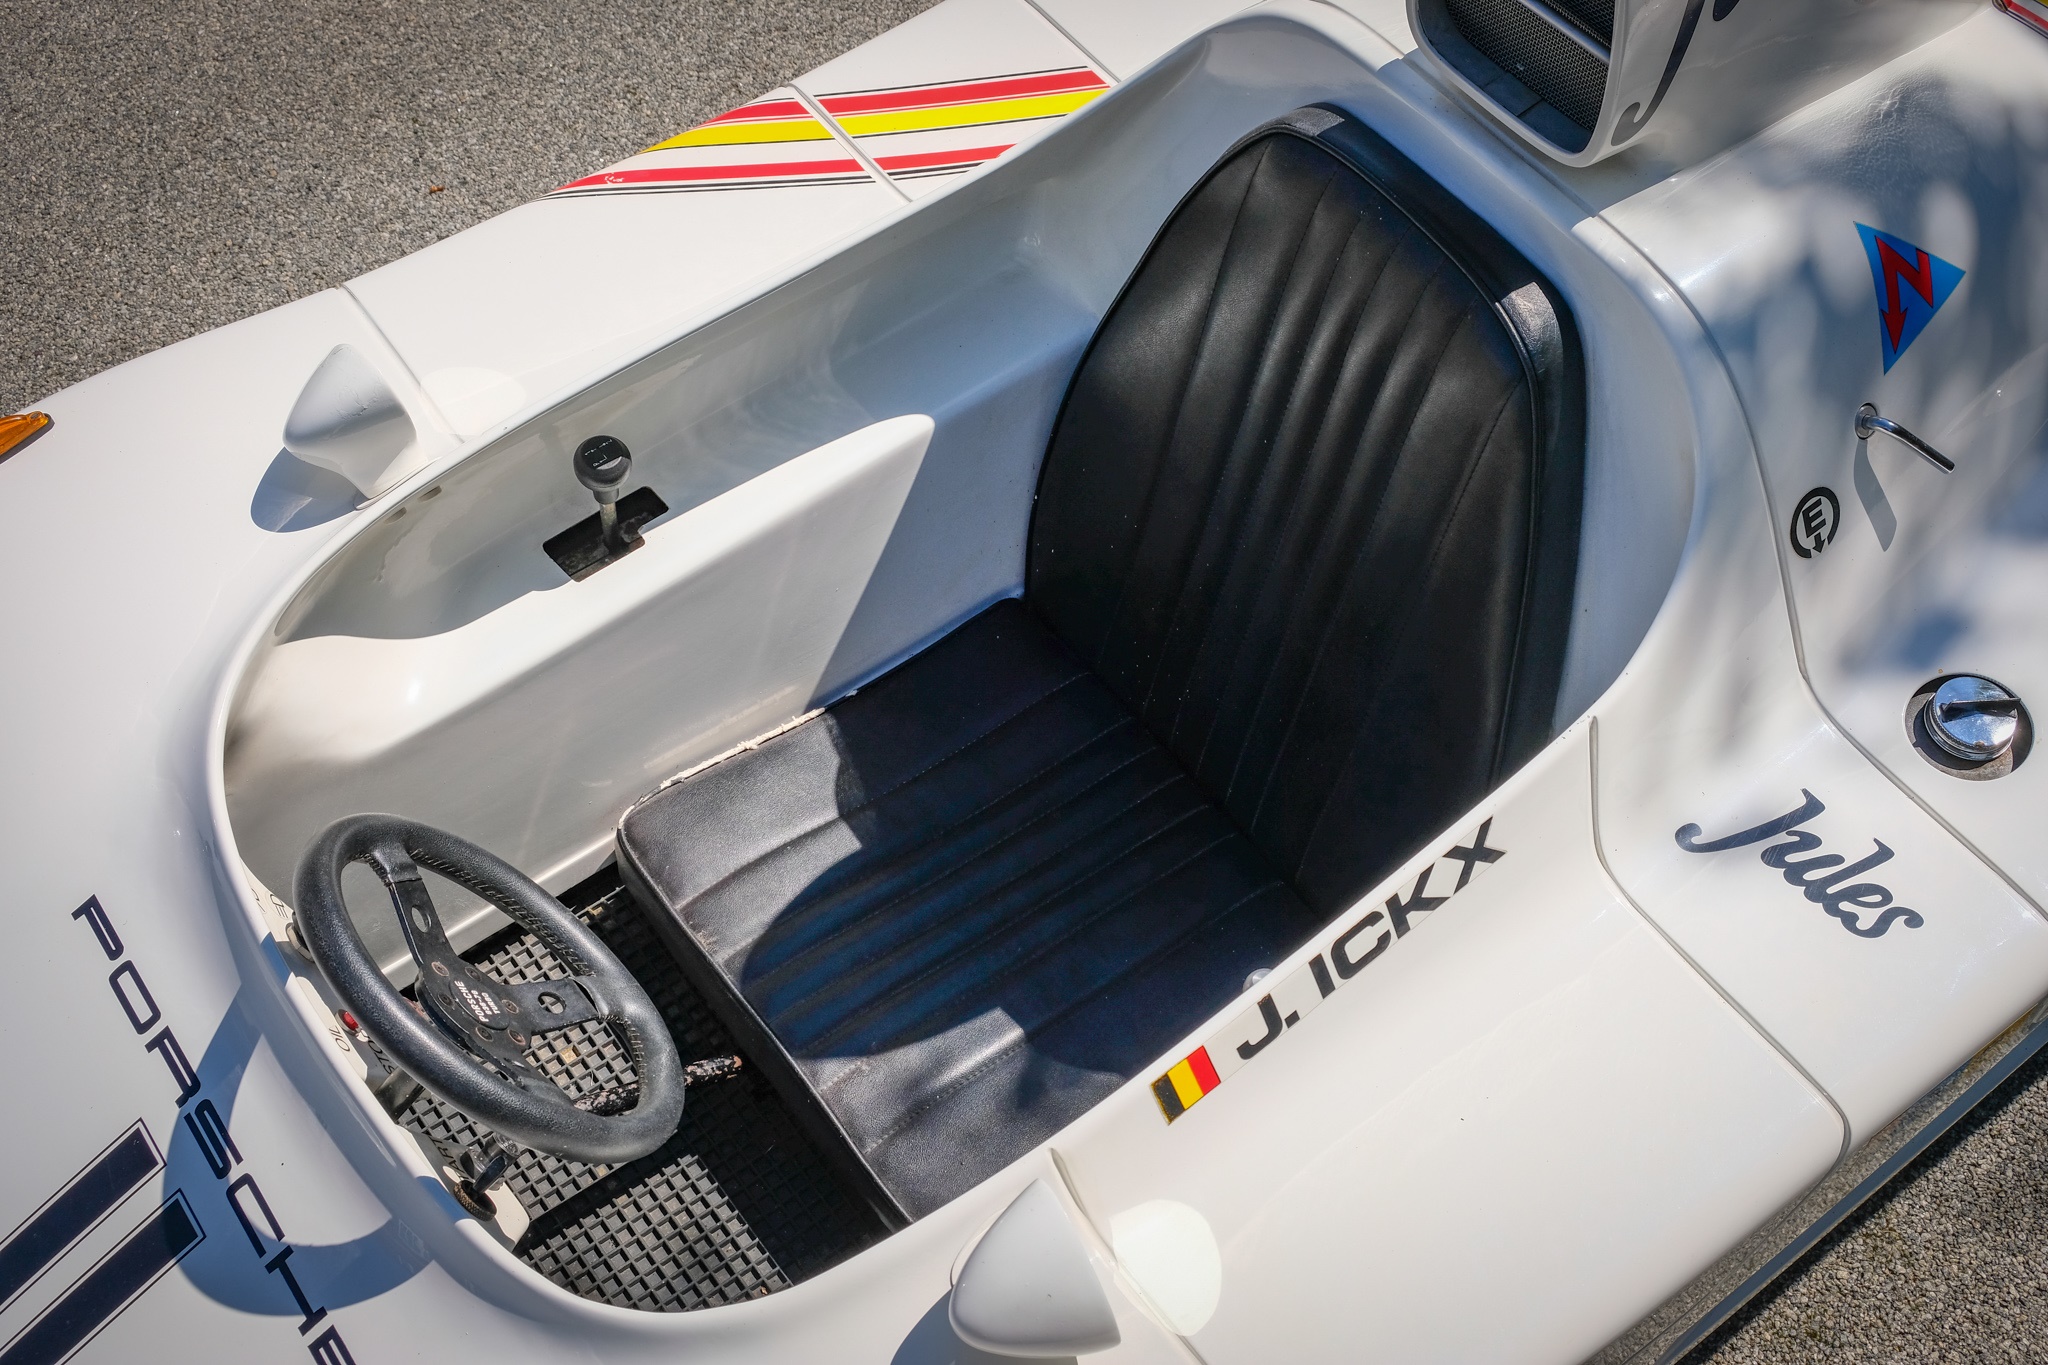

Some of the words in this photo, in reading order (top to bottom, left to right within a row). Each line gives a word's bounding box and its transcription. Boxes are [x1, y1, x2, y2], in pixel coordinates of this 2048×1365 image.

[1675, 788, 1924, 938] Jules
[1236, 993, 1300, 1060] J.
[1308, 815, 1507, 1000] ICKX
[454, 980, 489, 1022] PORSCHE
[481, 992, 500, 1014] TURBO
[328, 1025, 350, 1052] OIL
[72, 894, 355, 1365] PORSCHE
[428, 1135, 470, 1180] TART
